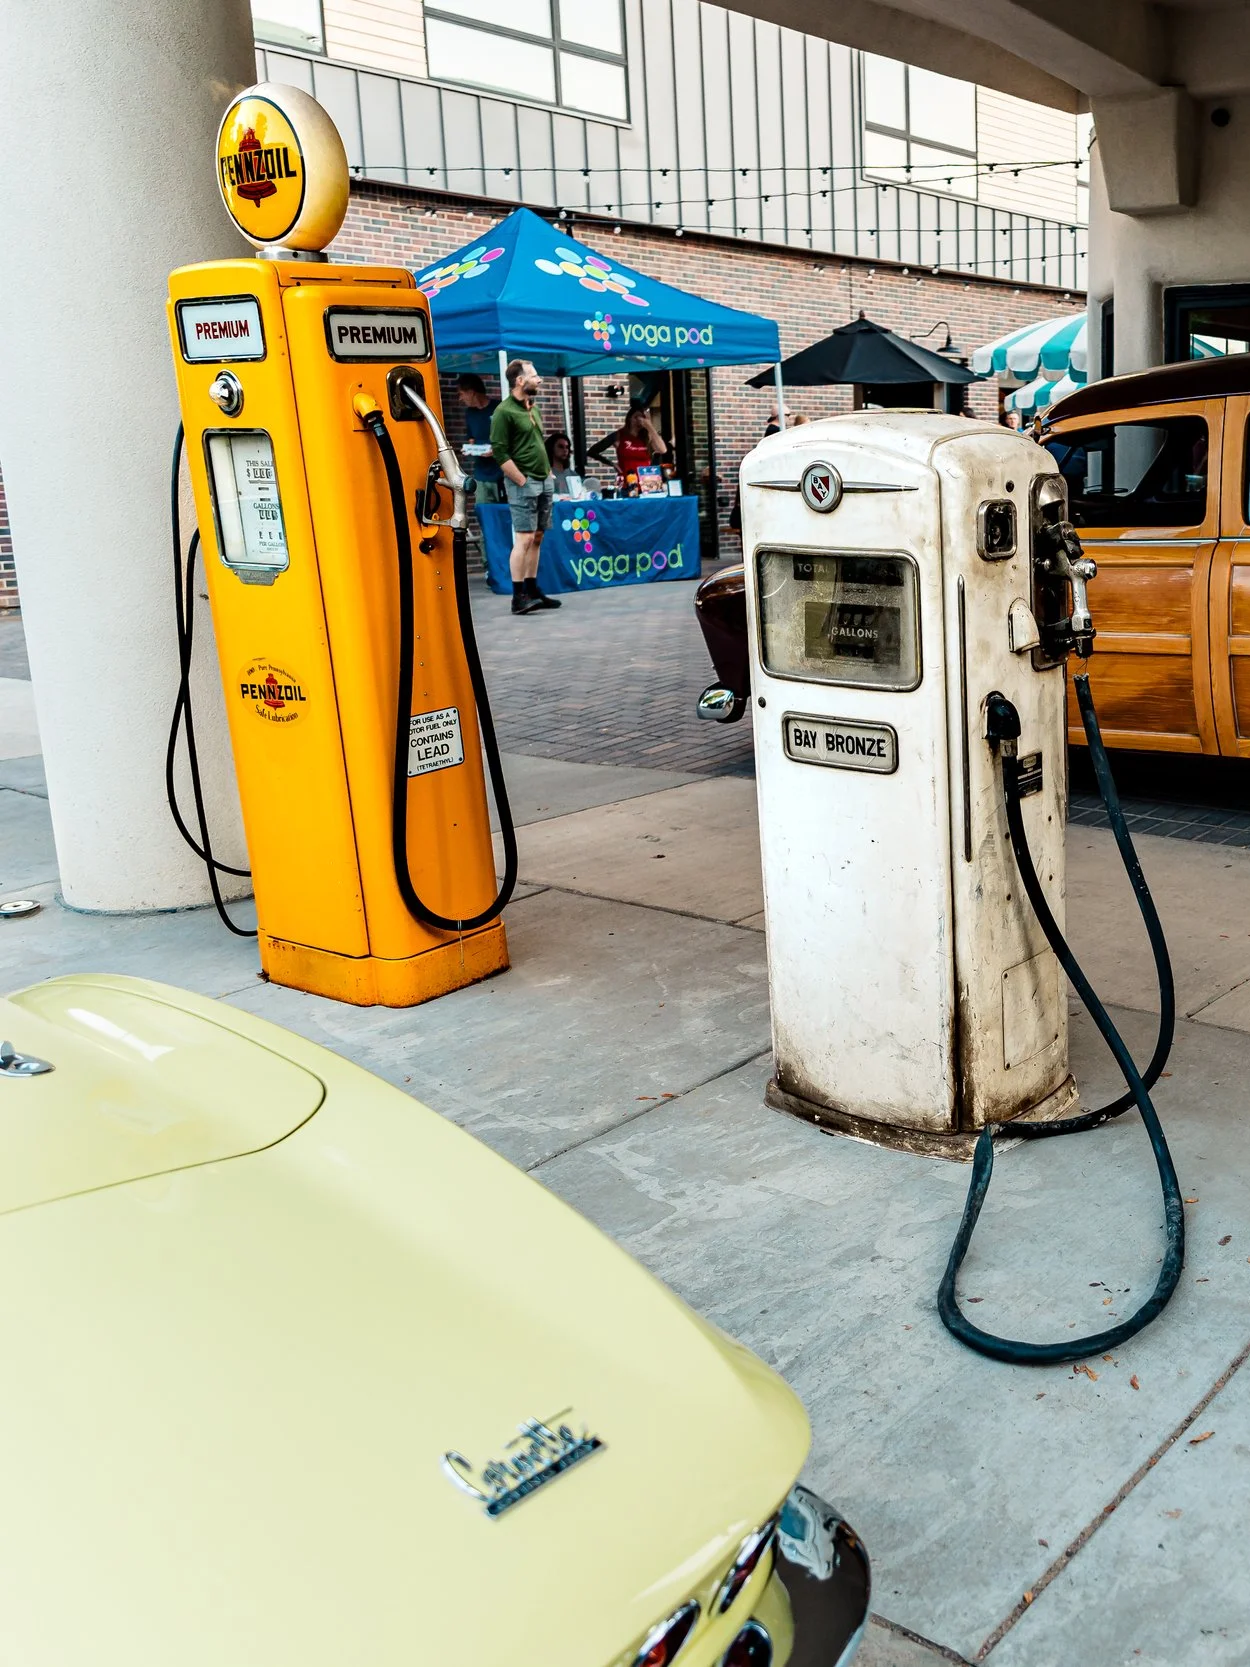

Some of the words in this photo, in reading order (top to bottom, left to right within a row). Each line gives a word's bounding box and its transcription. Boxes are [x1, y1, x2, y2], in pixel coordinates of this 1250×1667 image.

[220, 147, 297, 187] PENNZOIL
[195, 319, 250, 340] PREMIUM
[338, 325, 417, 345] PREMIUM
[620, 323, 671, 347] yoga
[675, 324, 713, 348] pod
[813, 476, 827, 498] BAY
[569, 553, 630, 585] yoga
[636, 543, 683, 577] pod
[831, 626, 878, 639] GALLONS
[240, 683, 306, 701] PENNZOIL
[409, 727, 424, 735] OTOR
[426, 723, 441, 731] FUEL
[442, 719, 457, 727] ONLY
[422, 716, 434, 724] USE
[410, 730, 454, 747] CONTAINS
[793, 723, 817, 749] BAY
[825, 732, 887, 758] BRONZE
[417, 743, 450, 761] LEAD
